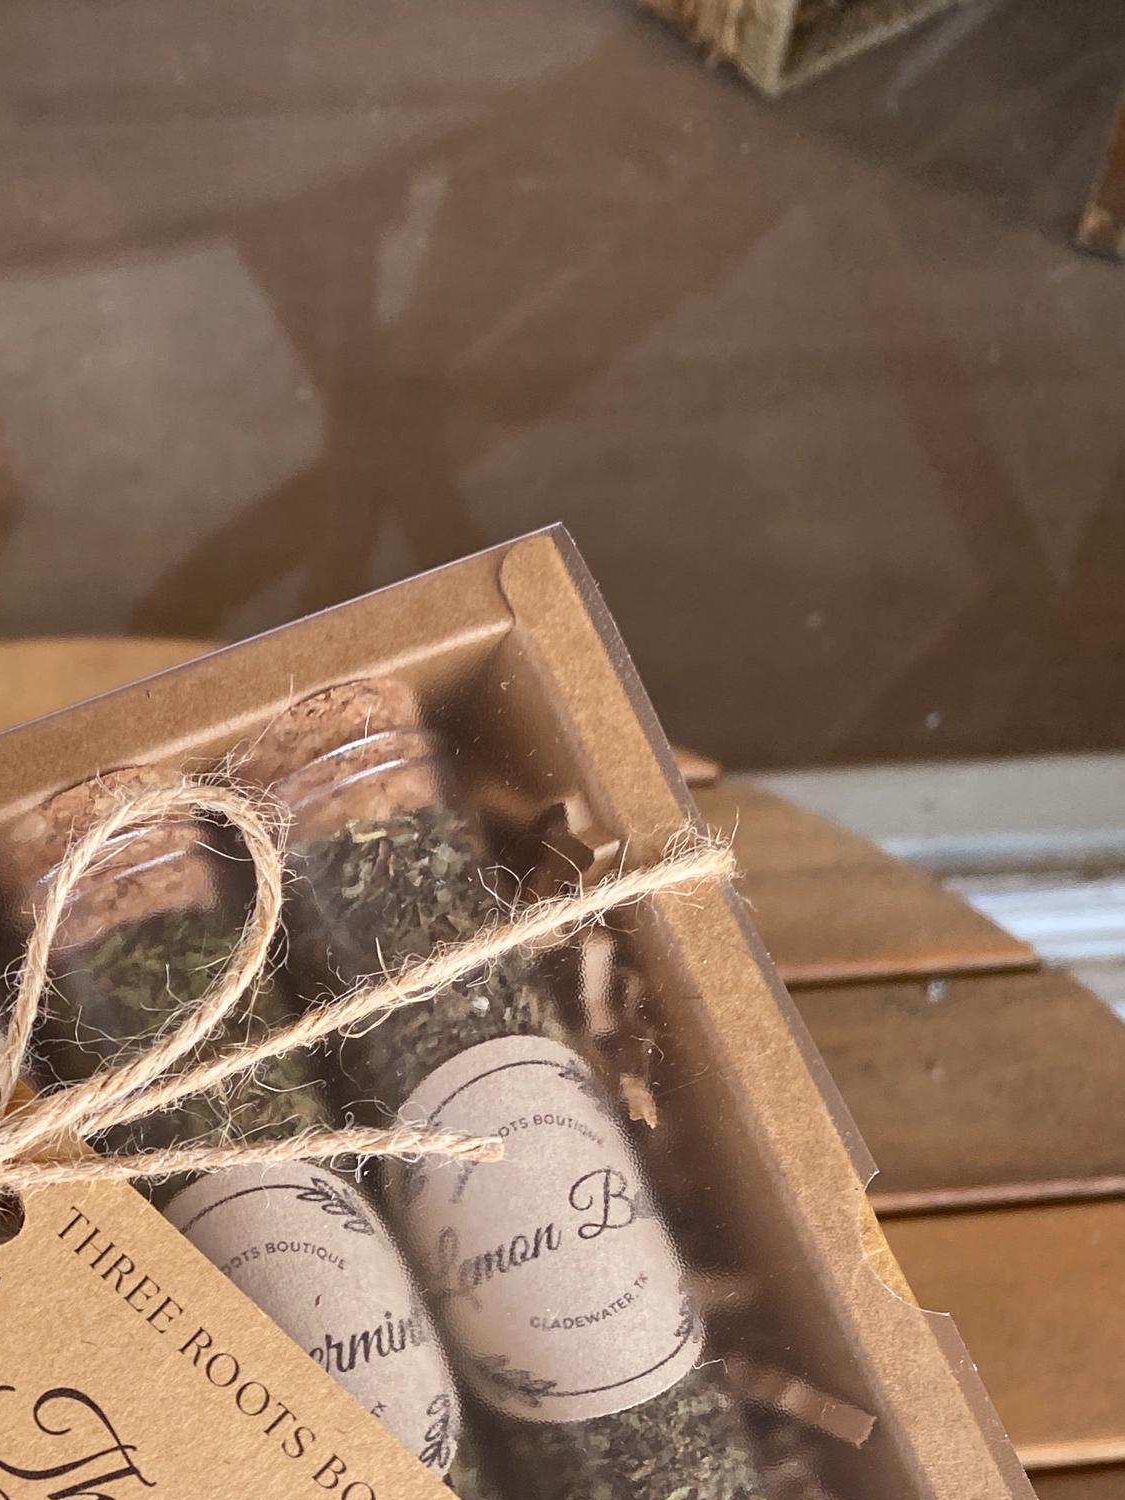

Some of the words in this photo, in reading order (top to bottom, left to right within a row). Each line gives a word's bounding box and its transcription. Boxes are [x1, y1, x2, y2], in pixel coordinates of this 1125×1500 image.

[264, 1240, 347, 1271] BOUTIQUE
[56, 1205, 184, 1334] THREE
[177, 1326, 317, 1459] ROOTS
